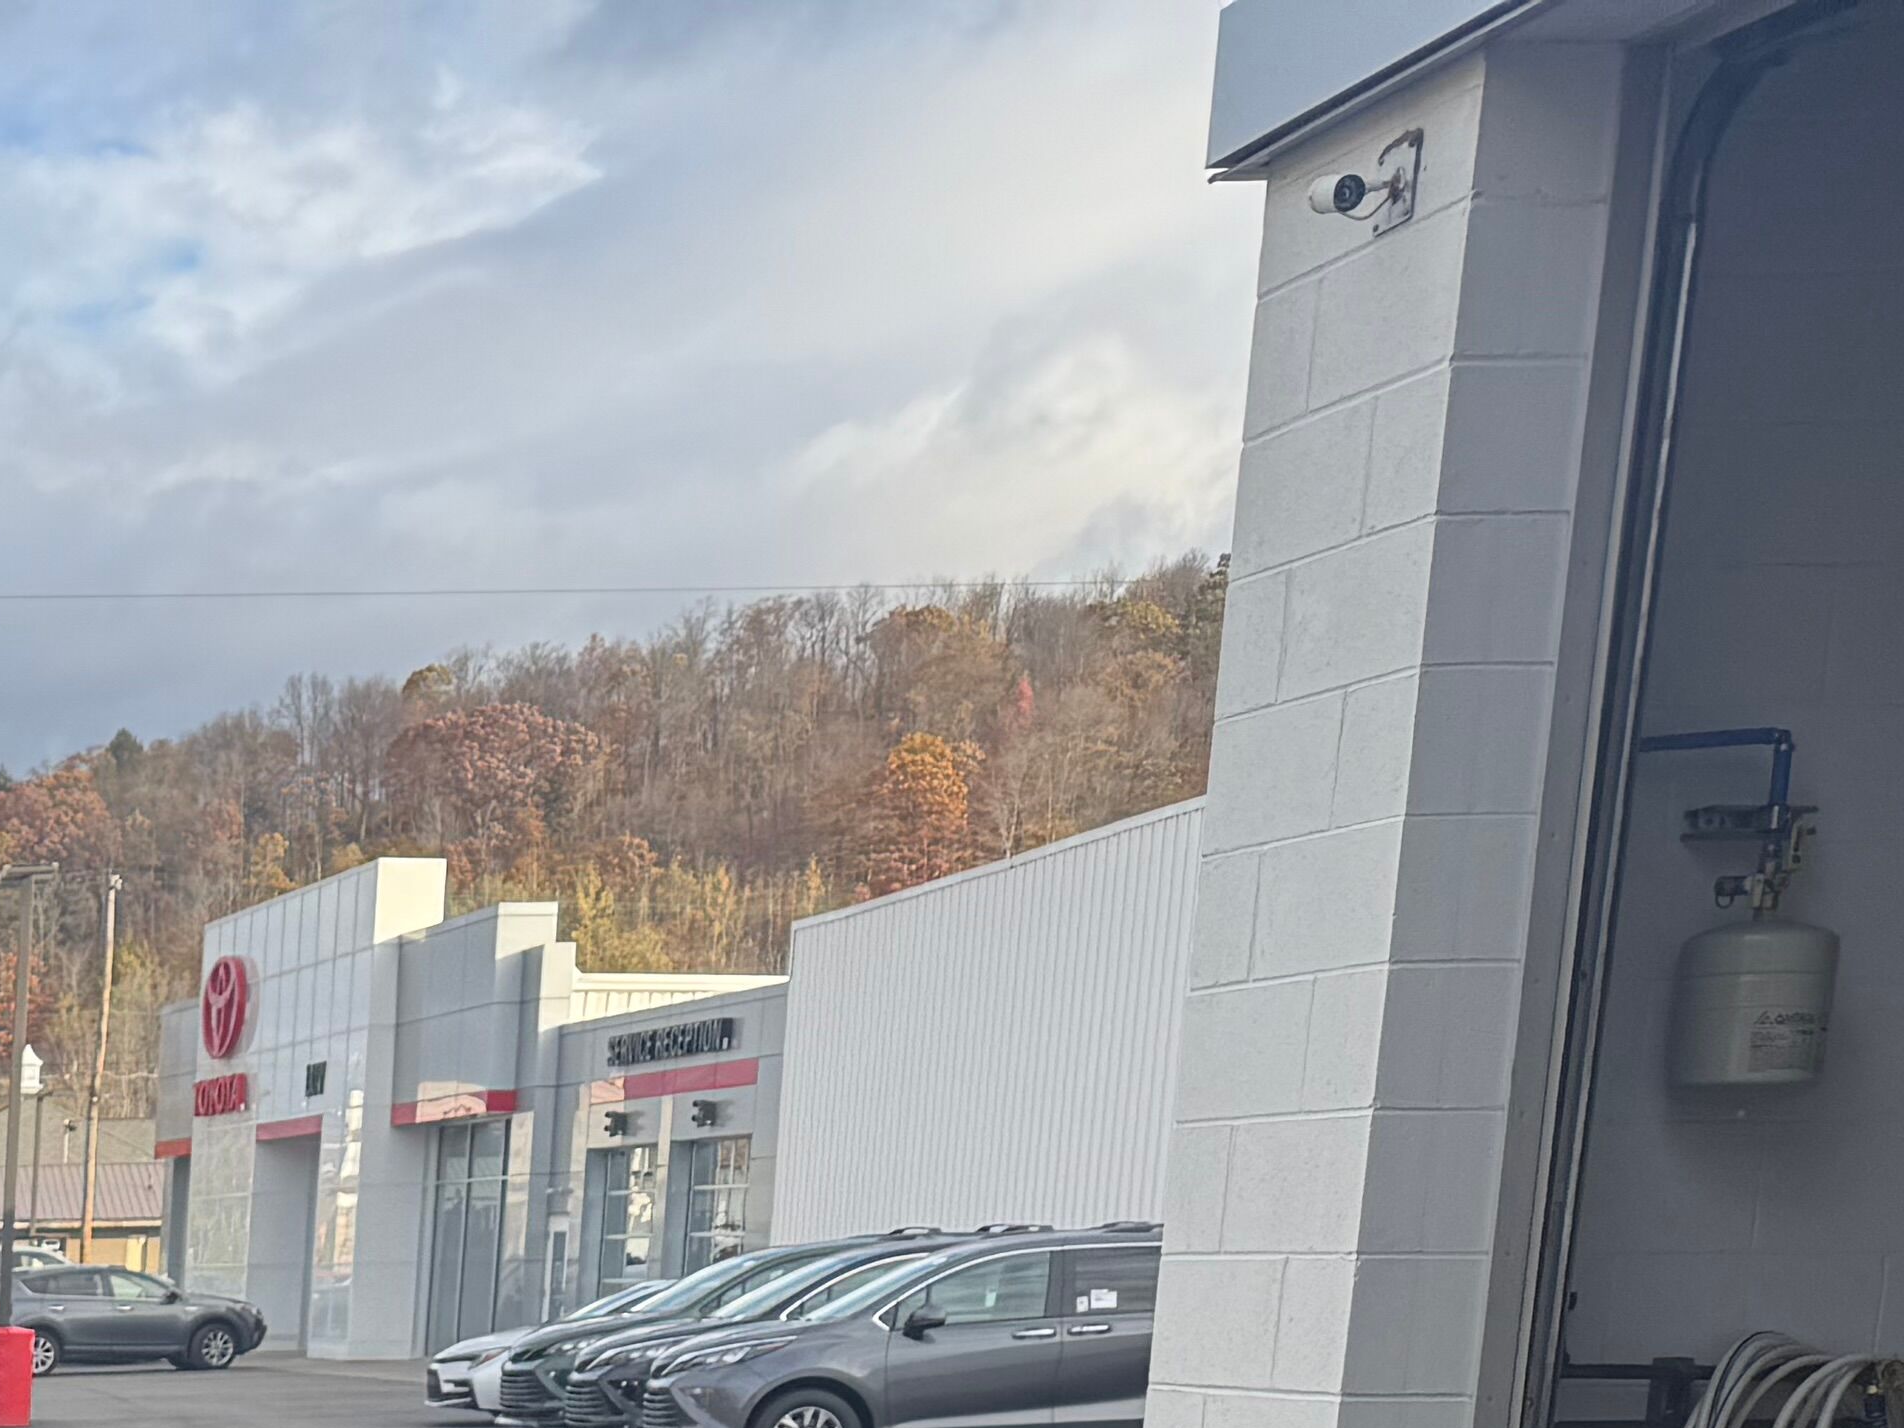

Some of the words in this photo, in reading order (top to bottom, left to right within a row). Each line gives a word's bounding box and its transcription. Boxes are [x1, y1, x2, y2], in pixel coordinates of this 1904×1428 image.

[607, 1031, 652, 1067] SERVICE
[655, 1017, 733, 1060] RECEPTION
[193, 1073, 248, 1117] TOYOTA
